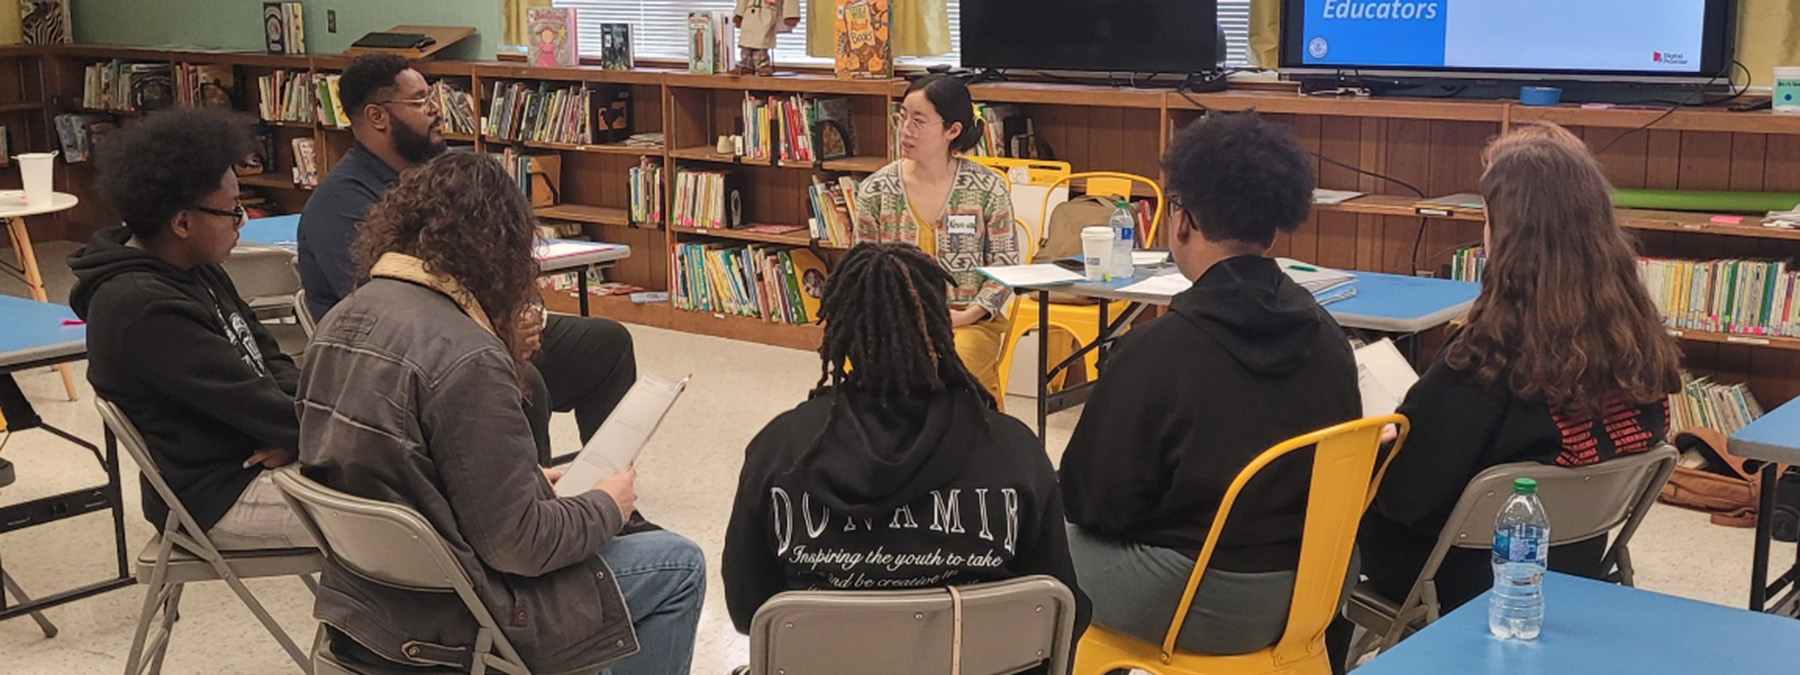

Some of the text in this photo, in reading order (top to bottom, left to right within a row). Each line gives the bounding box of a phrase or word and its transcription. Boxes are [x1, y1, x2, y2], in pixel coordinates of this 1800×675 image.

[1323, 0, 1438, 19] Educators
[789, 545, 1004, 572] Inspiring the youth to take
[854, 573, 876, 588] be
